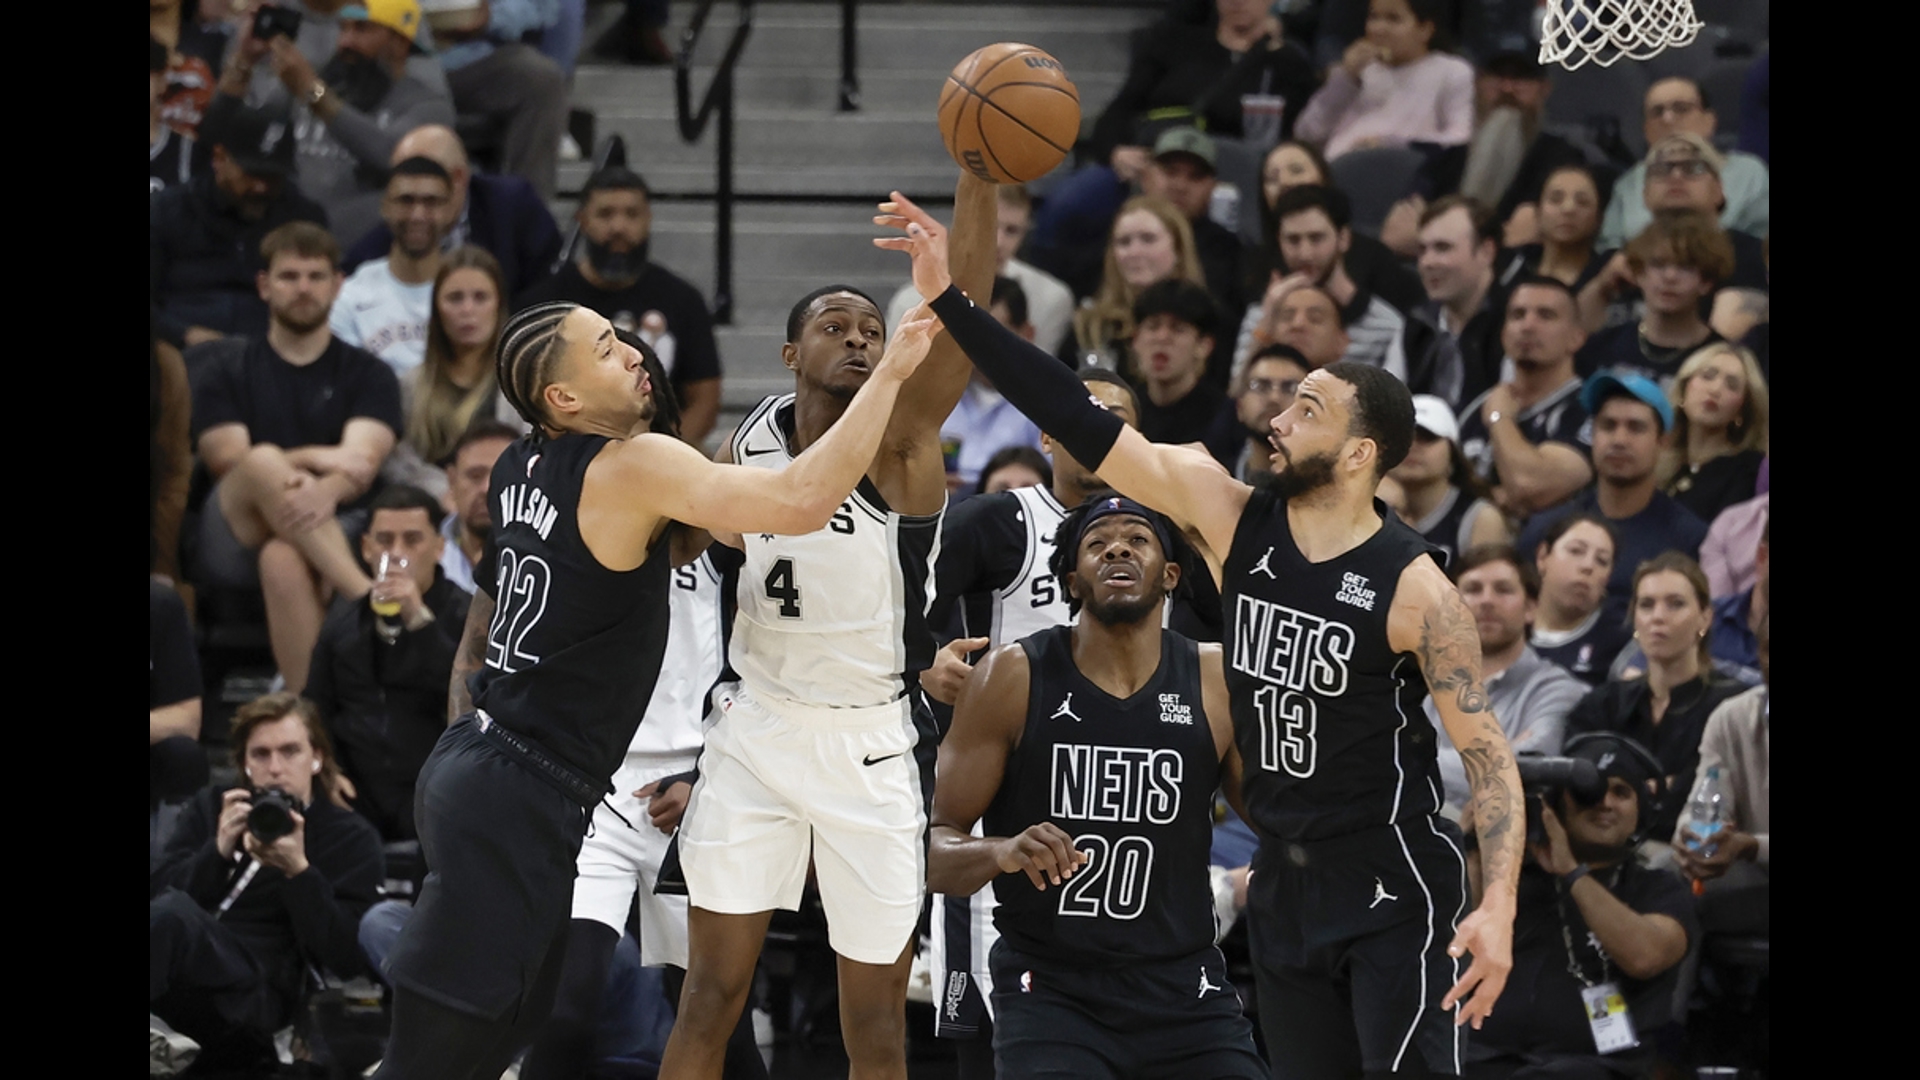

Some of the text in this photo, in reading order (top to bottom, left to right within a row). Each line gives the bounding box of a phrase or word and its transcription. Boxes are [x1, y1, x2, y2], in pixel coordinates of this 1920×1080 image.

[764, 555, 803, 620] 4
[1343, 571, 1370, 587] GET
[1335, 590, 1375, 611] GUIDE
[1341, 580, 1376, 601] YOUR
[1232, 593, 1355, 697] NETS
[1158, 693, 1180, 704] GET
[1160, 703, 1191, 715] YOUR
[1160, 712, 1194, 725] GUIDE
[1253, 685, 1317, 779] 13
[1051, 743, 1183, 824] NETS
[1058, 834, 1154, 919] 20
